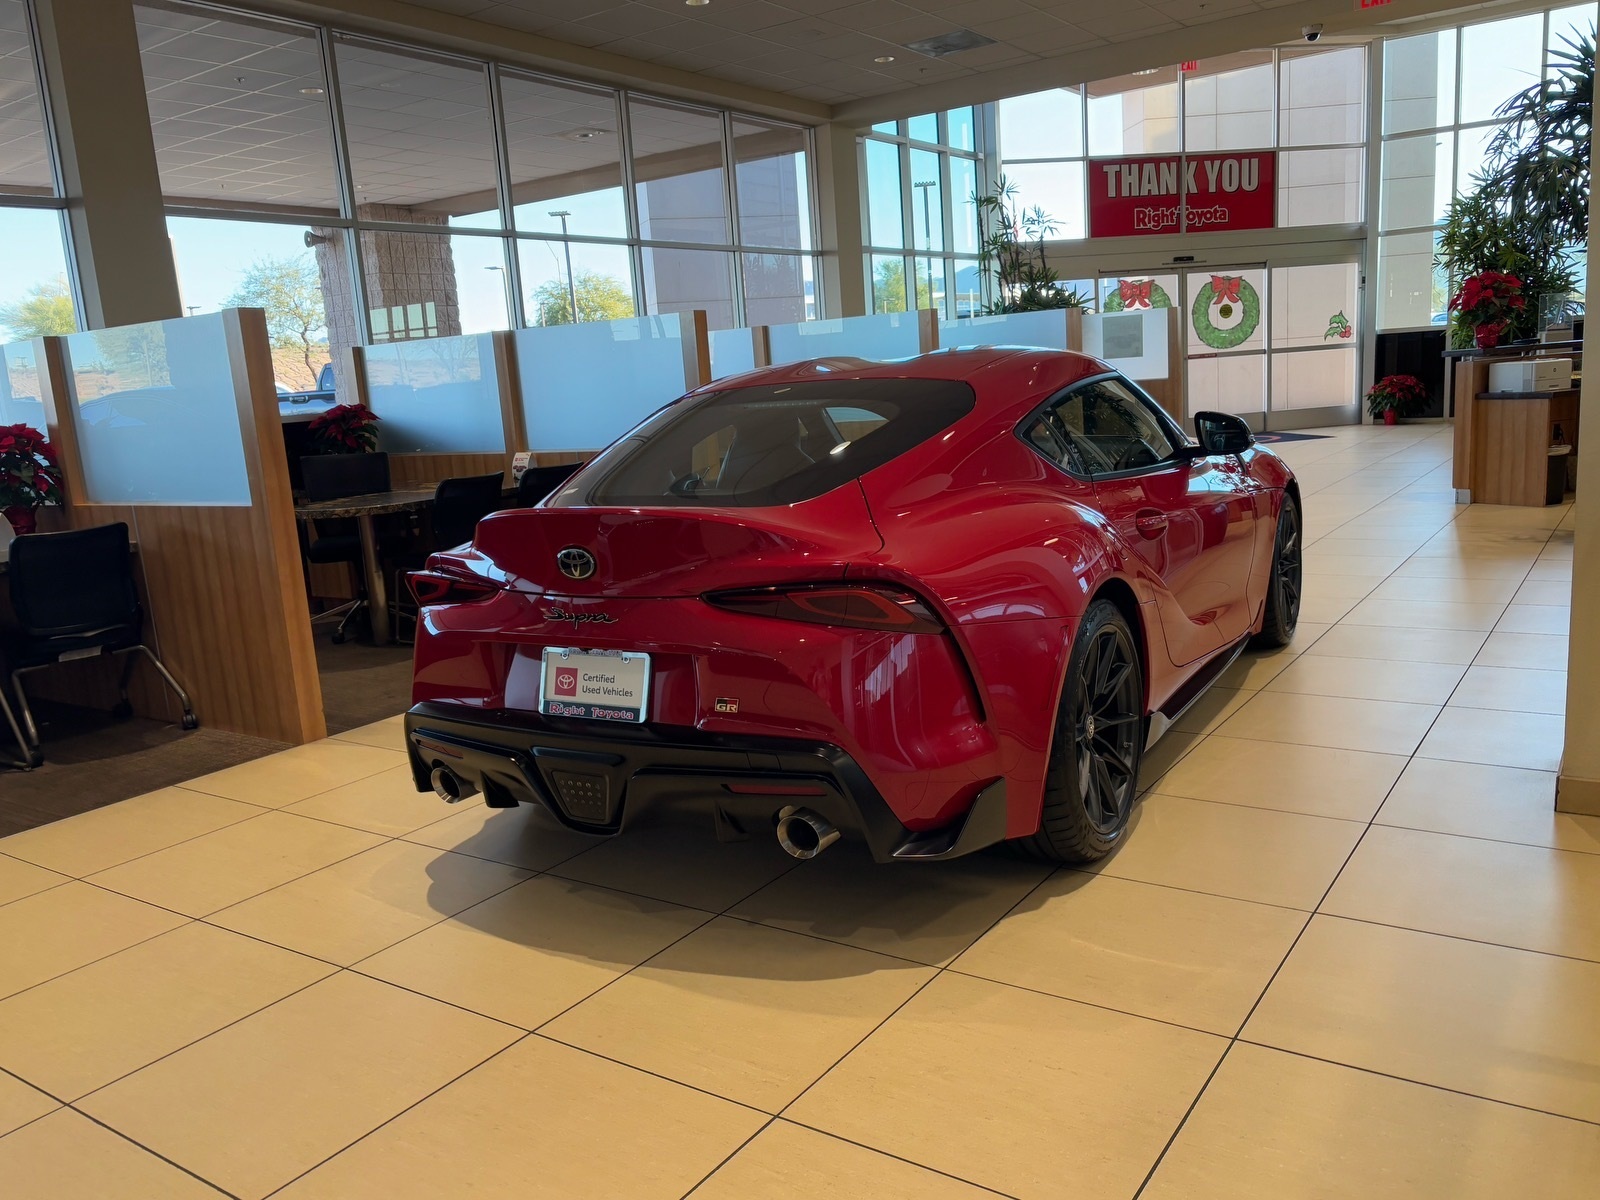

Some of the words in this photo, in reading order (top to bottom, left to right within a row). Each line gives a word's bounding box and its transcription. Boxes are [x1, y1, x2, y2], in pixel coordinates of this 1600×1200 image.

[1103, 161, 1198, 198] THANK
[1205, 158, 1260, 193] YOU
[1134, 207, 1177, 230] Right
[543, 606, 618, 630] Supra
[582, 673, 616, 684] Certified
[582, 685, 601, 695] Used
[602, 686, 633, 697] Vehicles
[549, 702, 585, 716] Right
[591, 707, 634, 720] Toyota
[716, 703, 737, 712] GR
